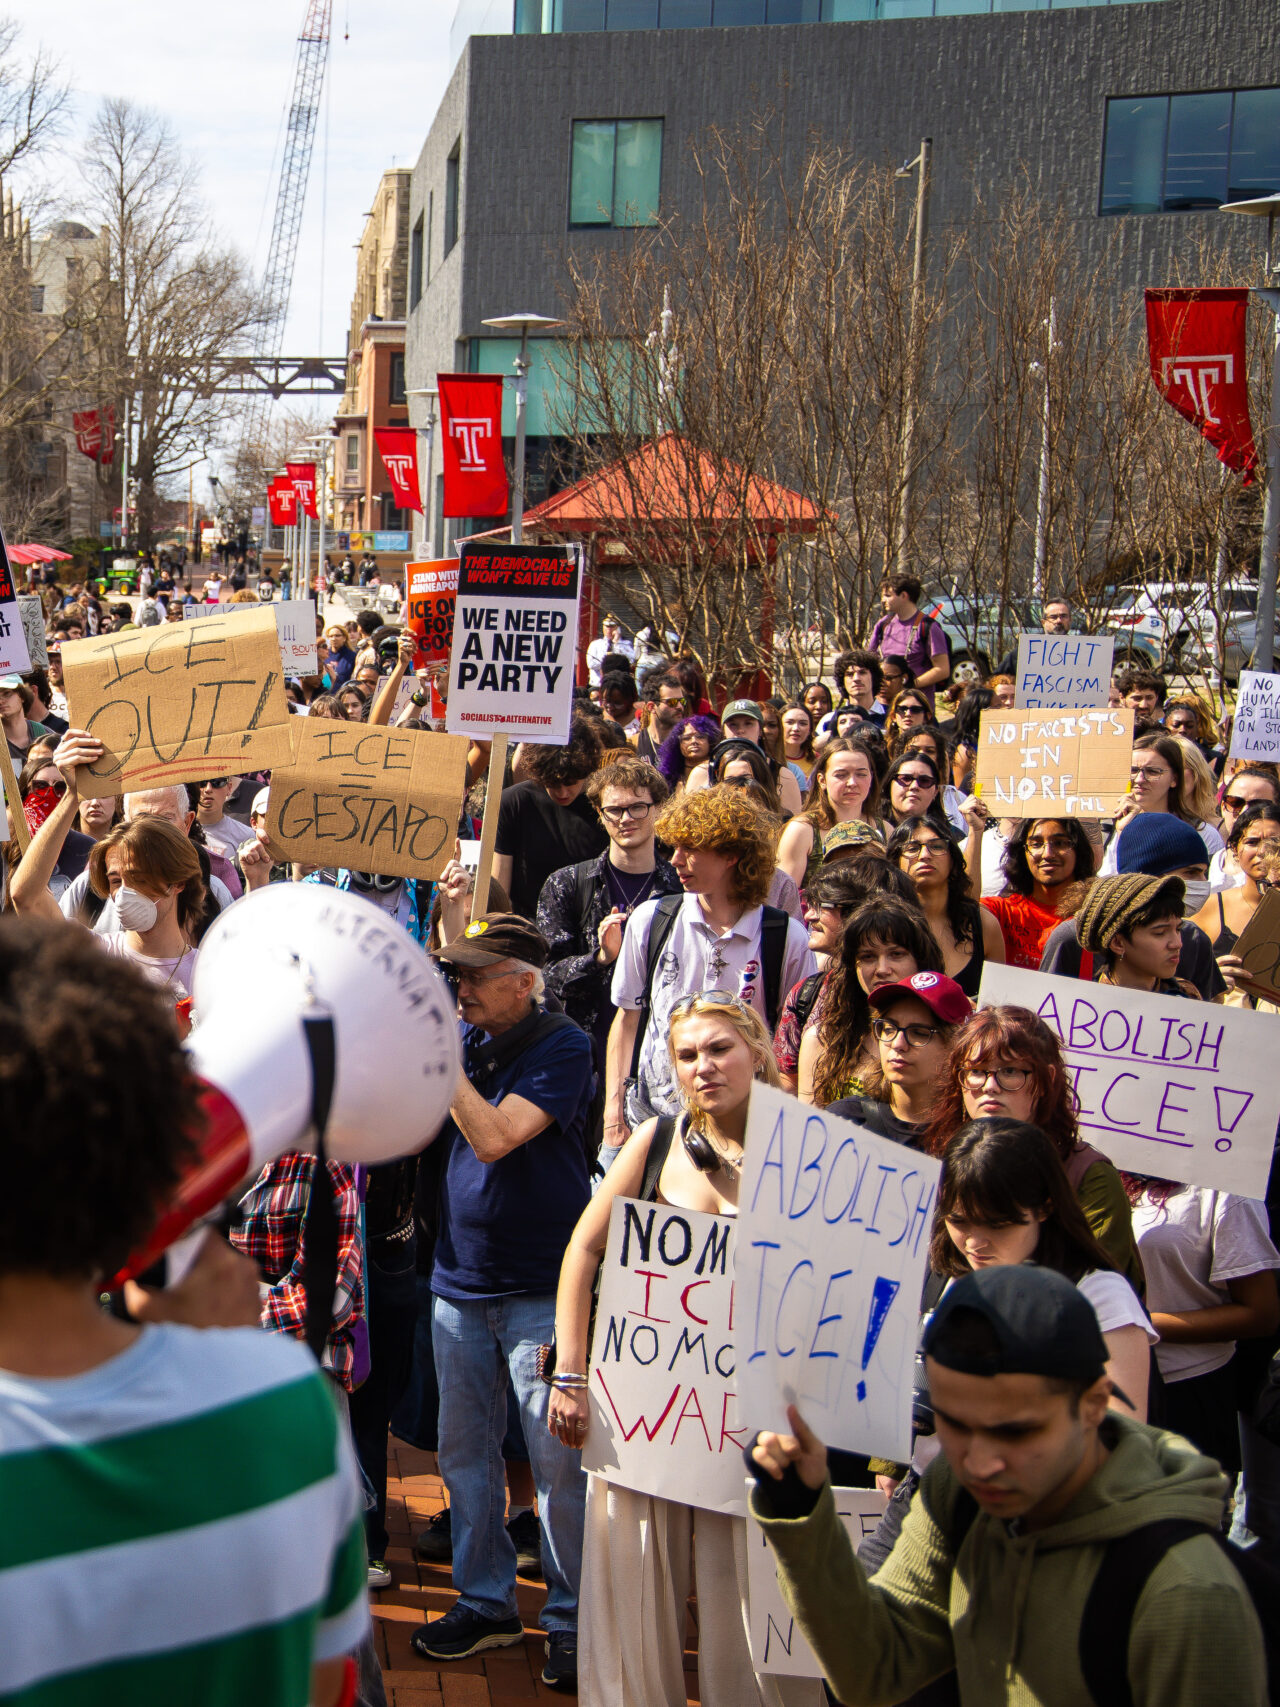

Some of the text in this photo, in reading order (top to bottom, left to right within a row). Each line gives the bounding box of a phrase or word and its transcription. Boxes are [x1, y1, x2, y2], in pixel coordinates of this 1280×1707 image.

[1161, 354, 1233, 425] T
[448, 418, 492, 472] T
[382, 455, 413, 491] T
[276, 490, 295, 511] T
[291, 480, 313, 506] T
[413, 572, 437, 584] STAND
[464, 556, 575, 573] THE DEMOCRATS
[467, 570, 570, 586] WON'T SAVE US
[410, 581, 458, 594] MINNEAPO
[410, 598, 455, 619] ICE OU
[462, 608, 567, 633] WE NEED
[92, 622, 226, 690] ICE
[419, 632, 453, 652] GOO
[461, 632, 563, 663] A NEW
[1027, 639, 1102, 668] FIGHT
[457, 662, 563, 694] PARTY
[1022, 673, 1104, 694] FASCISM.
[1254, 678, 1273, 691] NO
[84, 671, 278, 779] OUT!
[460, 713, 552, 725] SOCIALIST ALTERNATIVE
[1237, 706, 1253, 717] IS
[1239, 720, 1255, 732] ON
[988, 712, 1126, 745] NO FASCISTS
[313, 730, 412, 770] ICE
[1020, 744, 1061, 769] IN
[994, 774, 1073, 805] NORF
[1065, 796, 1106, 814] PHL
[278, 787, 449, 861] GESTAPO
[1037, 992, 1225, 1069] ABOLISH
[1065, 1063, 1254, 1153] ICE!
[750, 1106, 936, 1258] ABOLISH
[748, 1240, 901, 1402] ICE!
[596, 1368, 748, 1453] WAR
